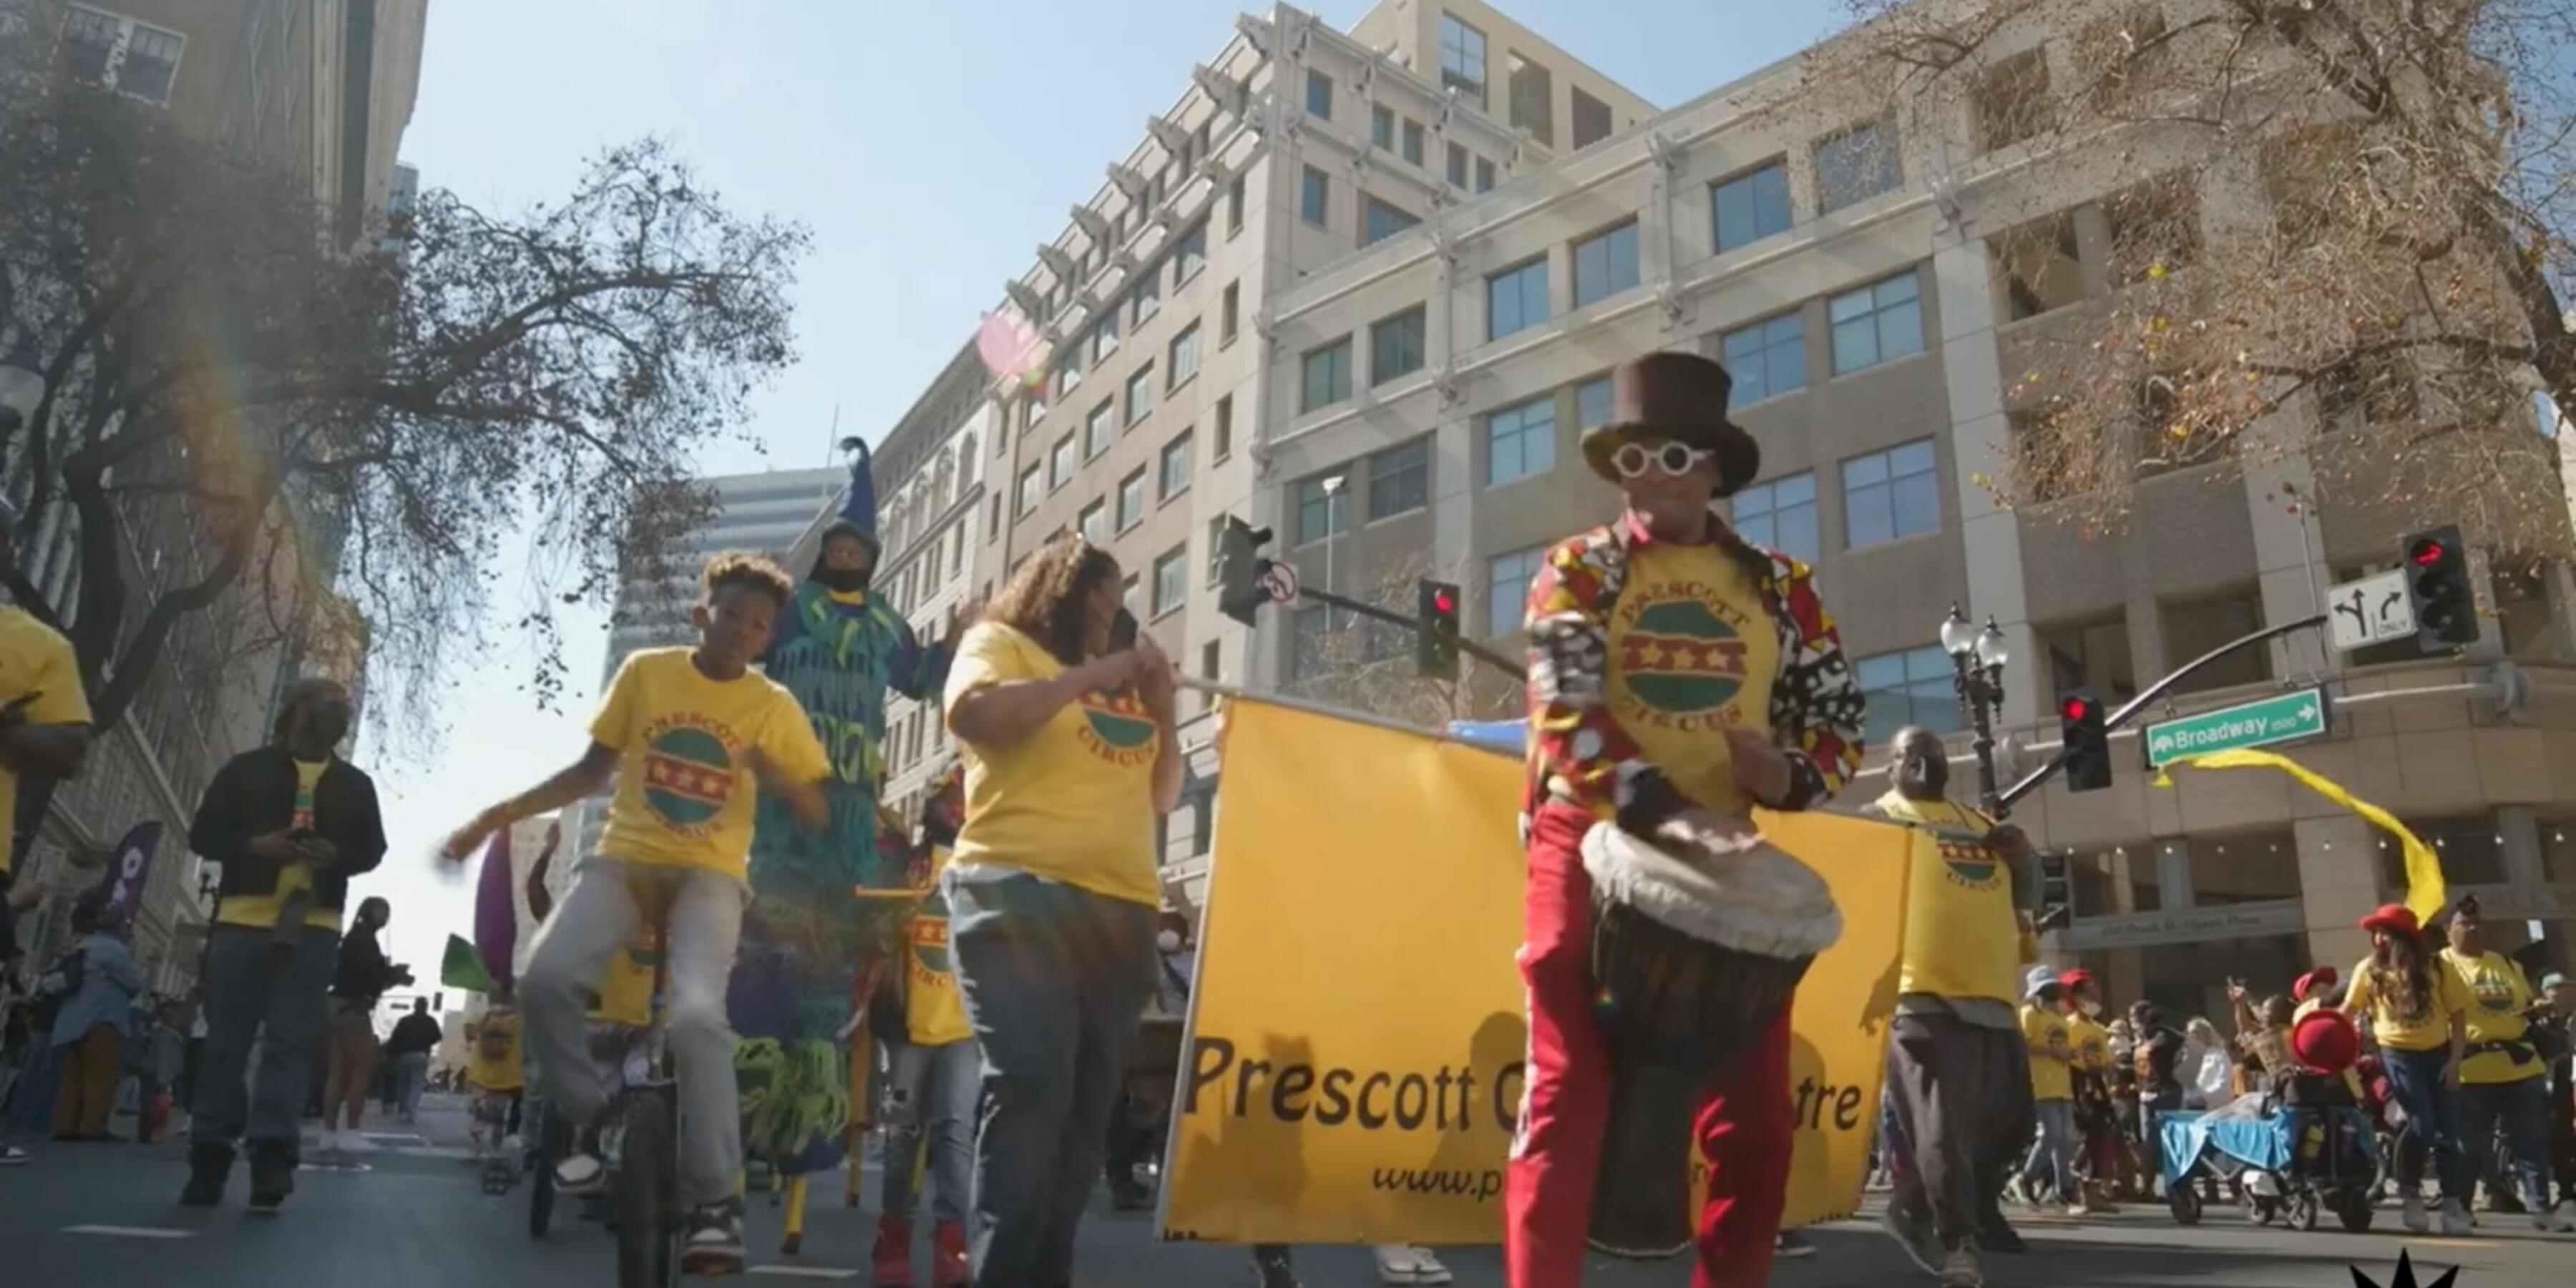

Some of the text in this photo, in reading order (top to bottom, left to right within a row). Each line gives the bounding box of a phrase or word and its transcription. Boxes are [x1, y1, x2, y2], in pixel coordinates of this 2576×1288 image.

[1619, 580, 1751, 625] PRESCOTT
[2379, 619, 2409, 635] ONLY
[2175, 716, 2268, 748] Broadway
[1184, 1037, 1475, 1132] Prescott
